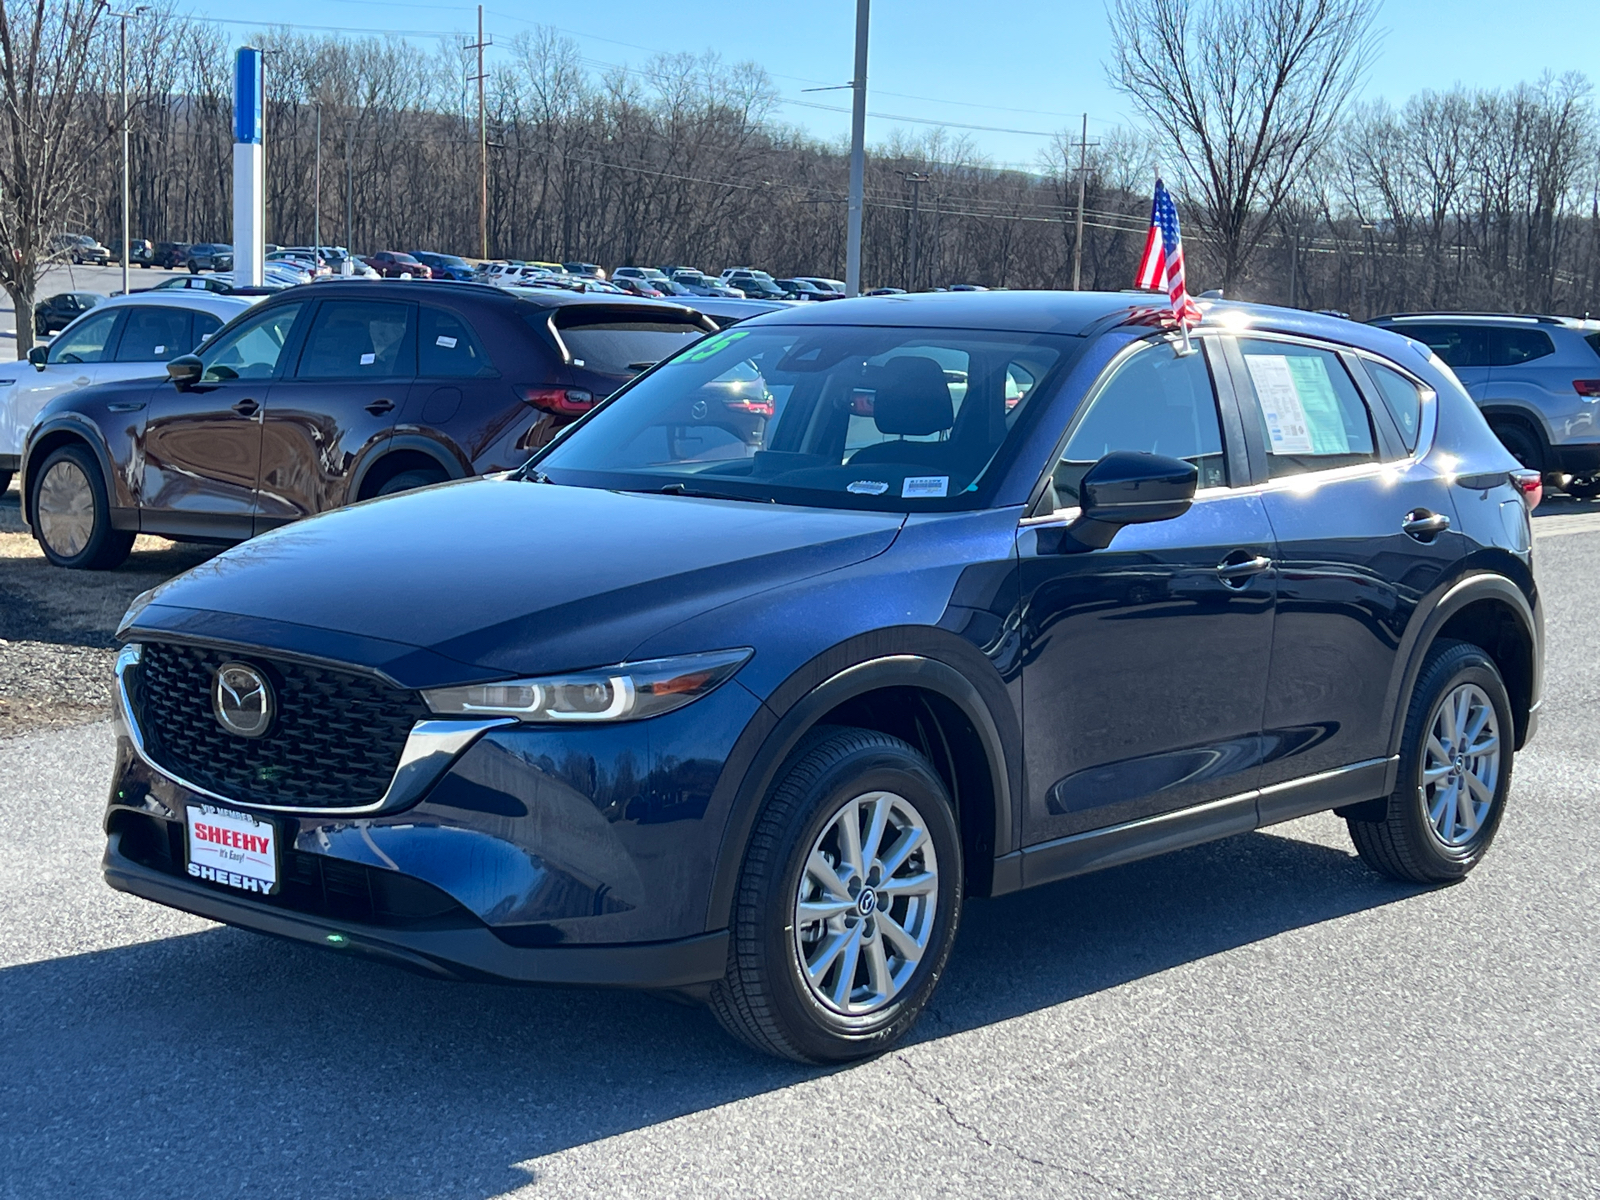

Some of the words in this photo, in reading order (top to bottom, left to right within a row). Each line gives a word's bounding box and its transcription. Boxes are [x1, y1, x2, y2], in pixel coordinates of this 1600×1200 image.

[194, 822, 270, 855] SHEEHY
[219, 848, 228, 859] It's
[229, 850, 245, 864] Easy!
[188, 863, 274, 895] SHEEHY
